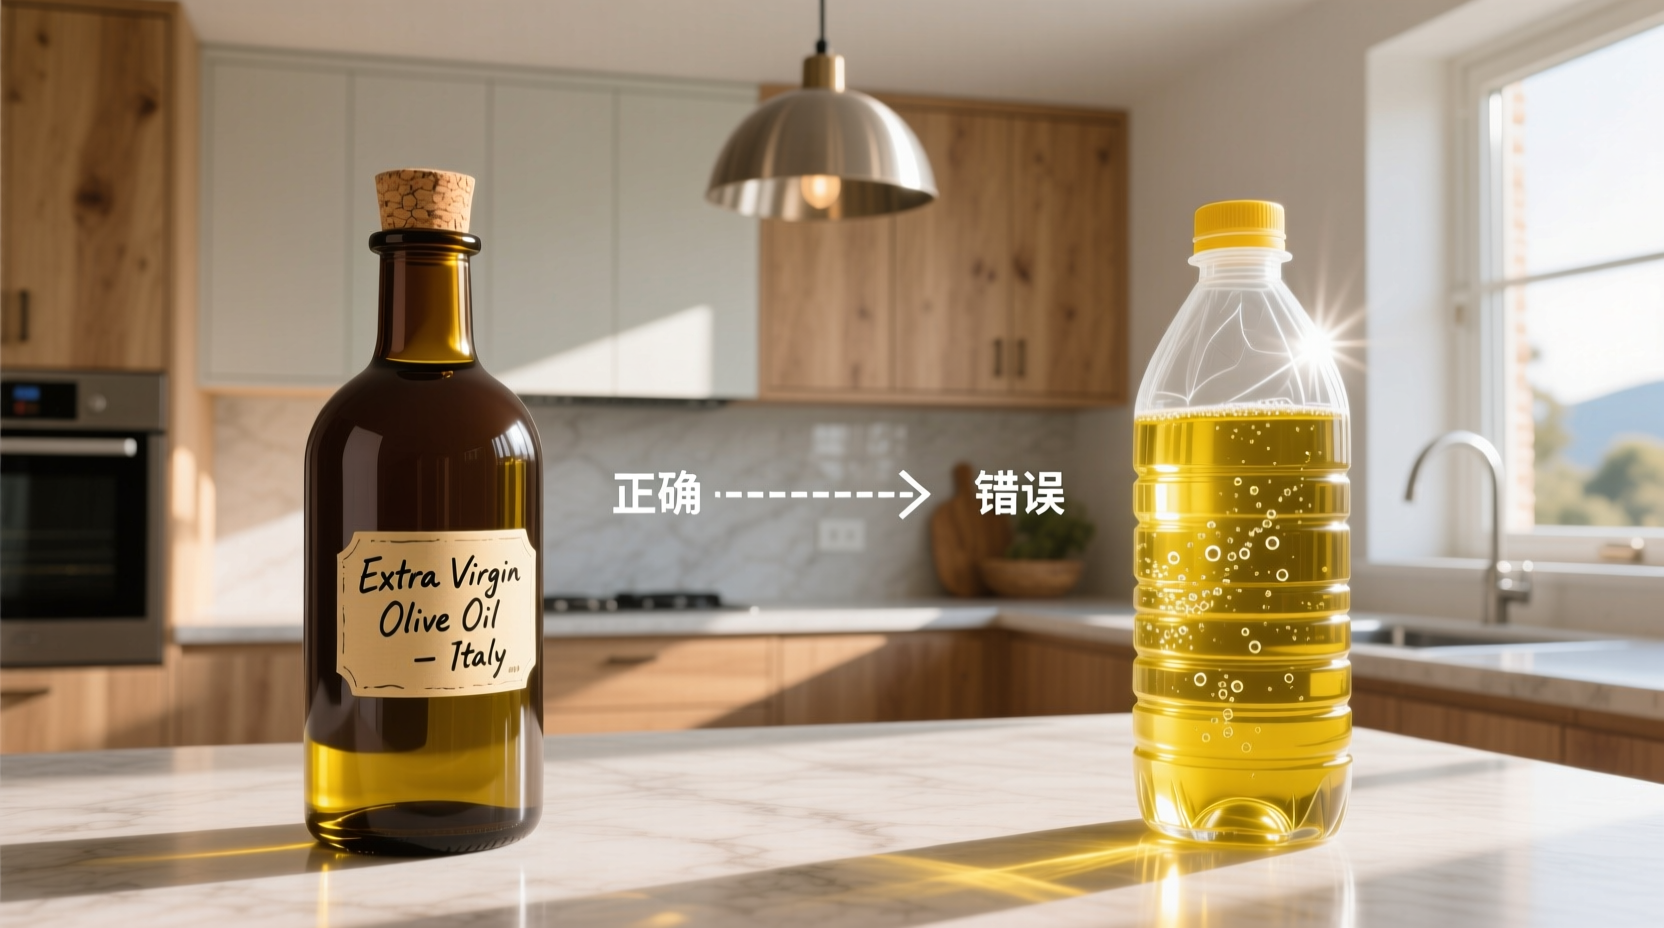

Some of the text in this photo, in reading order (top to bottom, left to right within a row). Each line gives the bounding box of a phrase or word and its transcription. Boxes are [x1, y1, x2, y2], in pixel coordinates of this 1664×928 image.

[359, 554, 521, 599] Extra Virgin
[379, 597, 501, 638] Olive Oil
[451, 638, 507, 679] Italy
